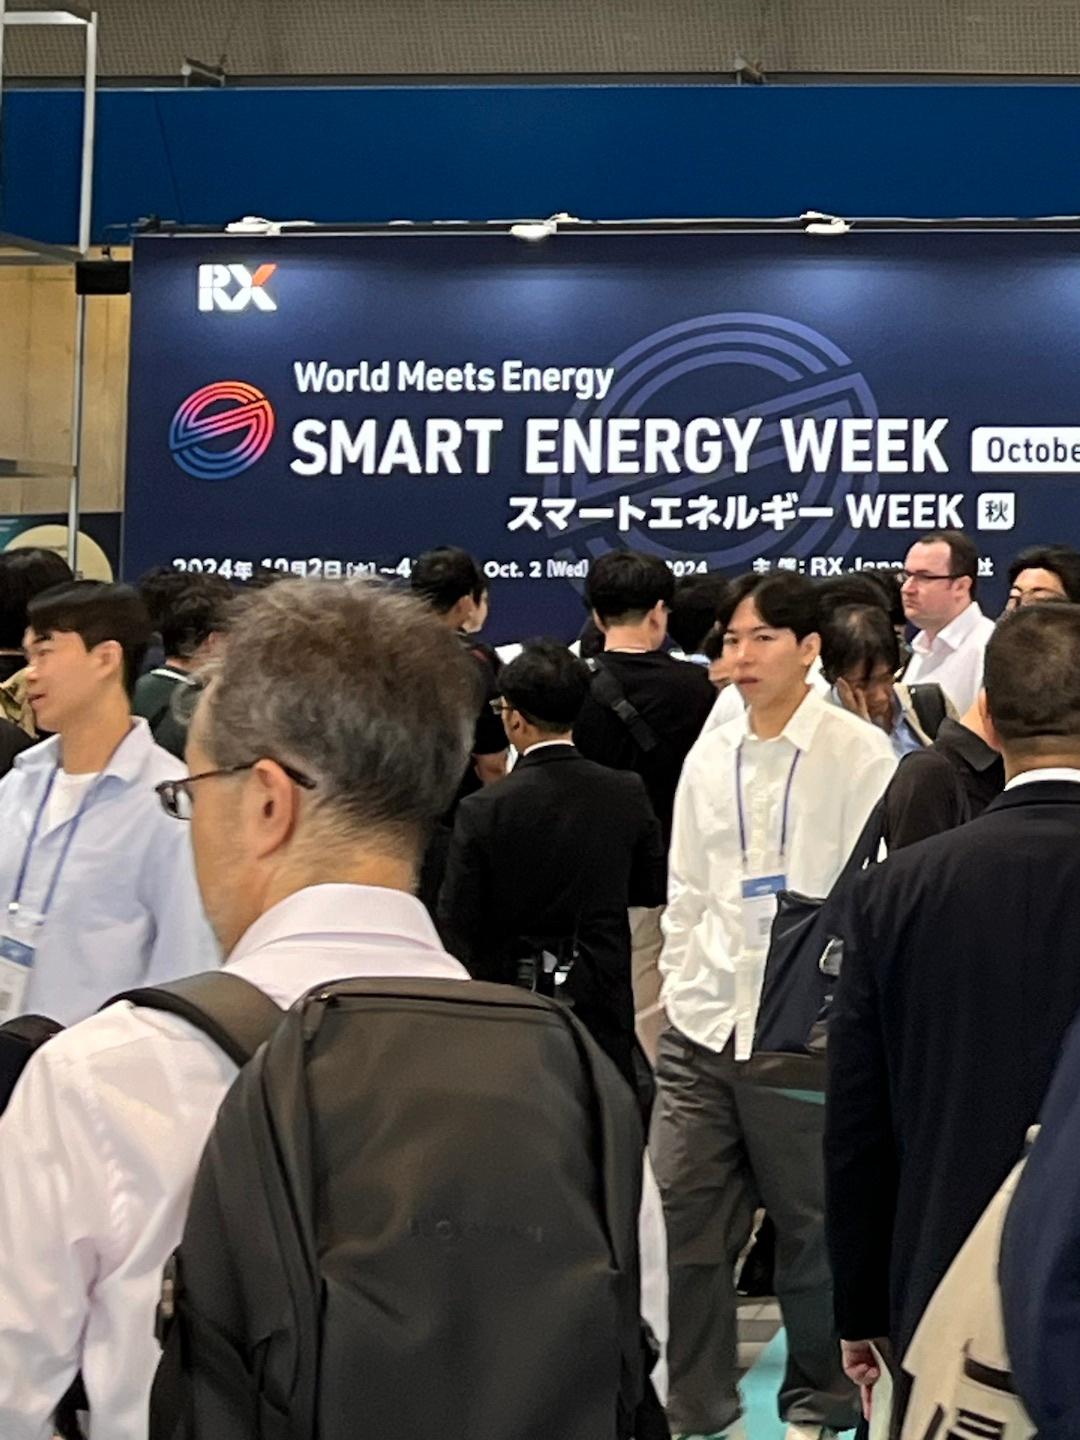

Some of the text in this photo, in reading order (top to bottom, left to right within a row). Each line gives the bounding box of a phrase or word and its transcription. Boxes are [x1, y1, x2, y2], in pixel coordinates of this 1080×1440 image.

[198, 263, 278, 311] RX
[293, 360, 614, 400] World Meets Energy
[289, 417, 503, 475] SMART
[525, 417, 763, 475] ENERGY
[780, 417, 949, 474] WEEK
[506, 491, 1009, 532] スマートエネルギー WEEK 秋
[483, 561, 524, 578] Oct.
[529, 560, 542, 578] 2
[546, 558, 589, 579] [Wed]
